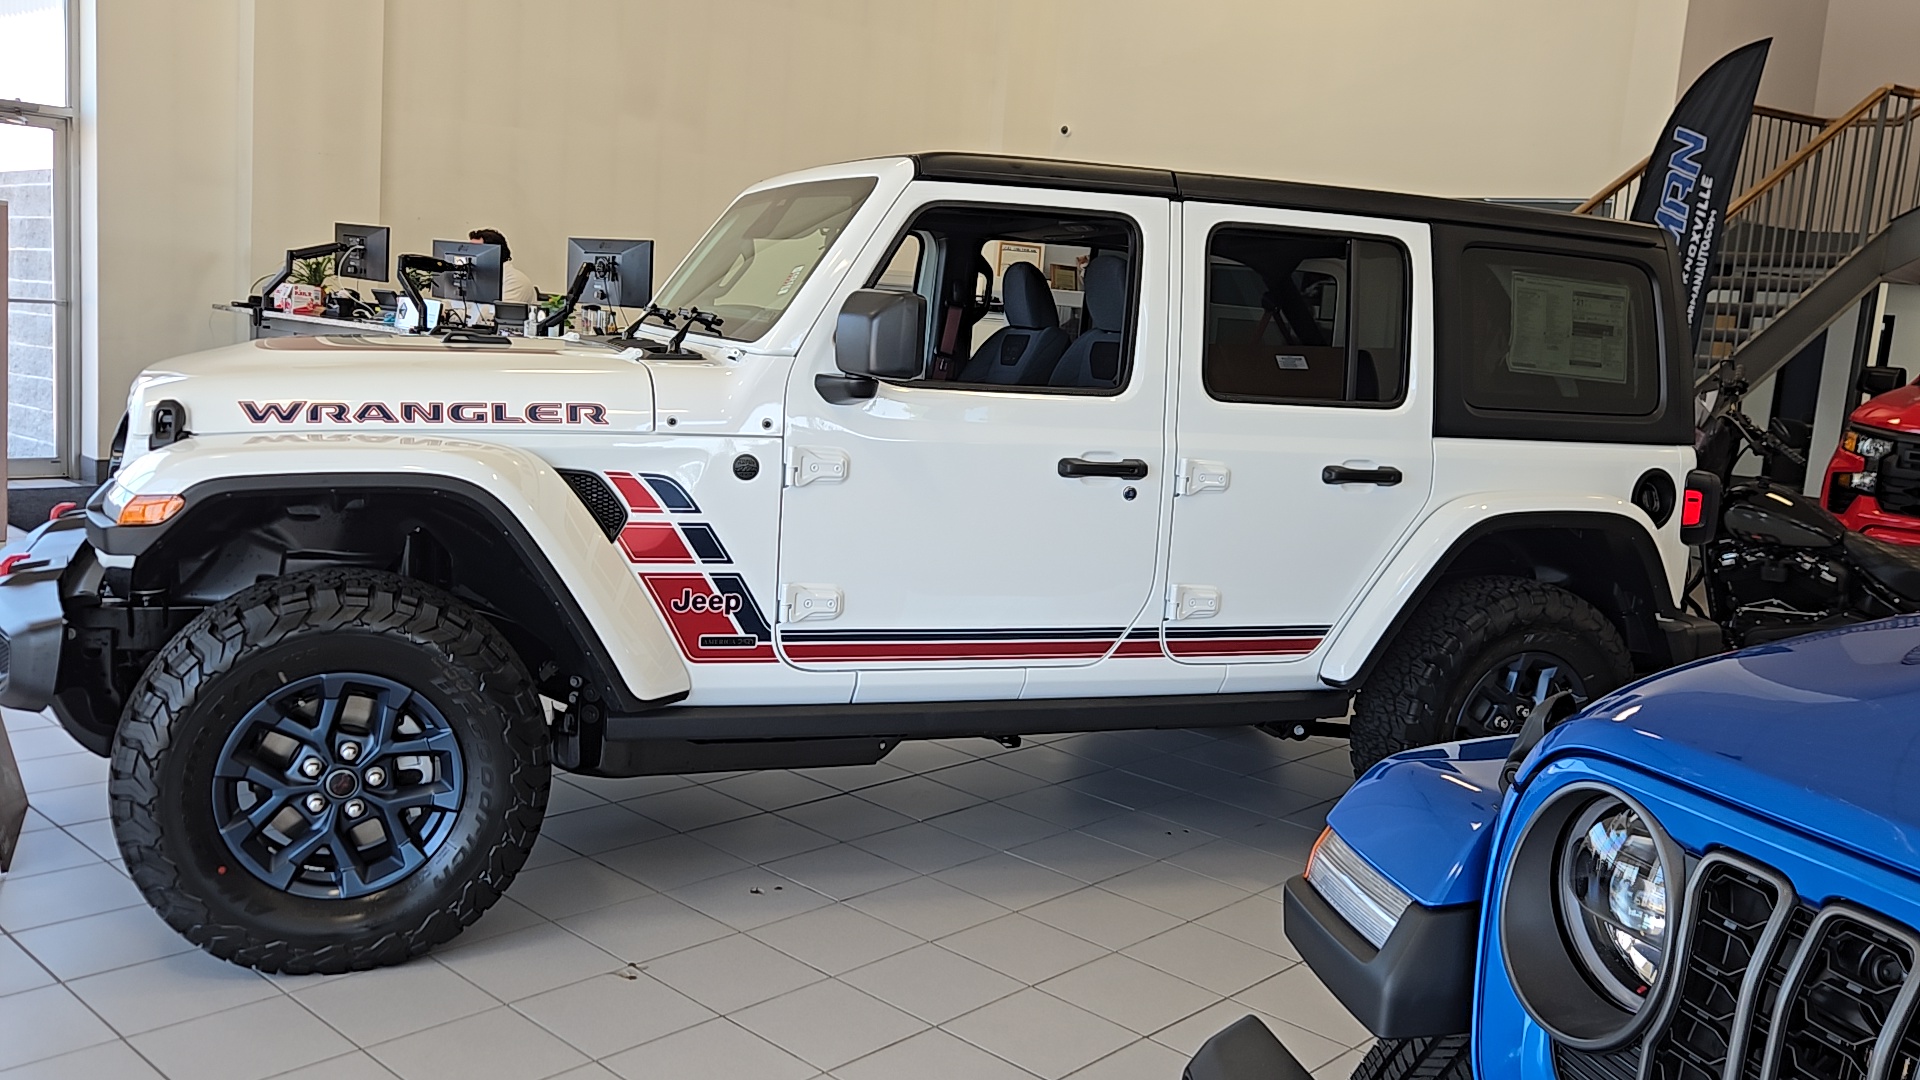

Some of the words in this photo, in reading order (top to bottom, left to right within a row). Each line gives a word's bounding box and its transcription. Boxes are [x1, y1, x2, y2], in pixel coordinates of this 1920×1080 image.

[1682, 173, 1714, 285] KNOXVILLE
[1687, 209, 1718, 325] ARMANAUTO.COM
[238, 400, 609, 425] WRANGLER
[672, 589, 742, 616] Jeep
